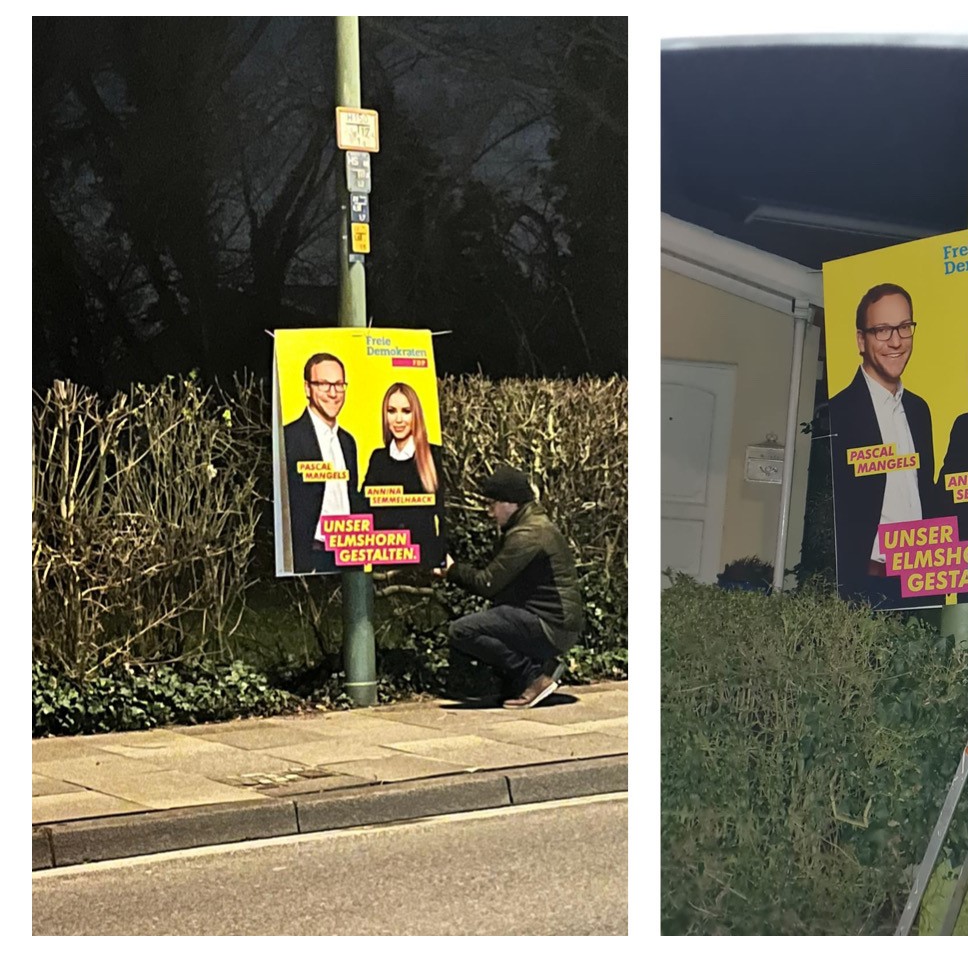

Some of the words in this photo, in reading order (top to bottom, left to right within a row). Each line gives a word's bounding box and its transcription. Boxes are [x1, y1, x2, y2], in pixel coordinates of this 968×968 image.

[366, 335, 391, 346] Freie
[367, 346, 427, 356] Demokraten
[850, 446, 894, 461] PASCAL
[300, 462, 331, 470] PASCAL
[857, 455, 916, 474] MANGELS
[305, 471, 347, 479] MANGELS
[372, 496, 432, 504] SEMMELHAACK
[323, 519, 370, 532] UNSER
[329, 533, 407, 548] ELMSHORN
[884, 525, 953, 549] UNSER
[340, 548, 417, 562] GESTALTEN.
